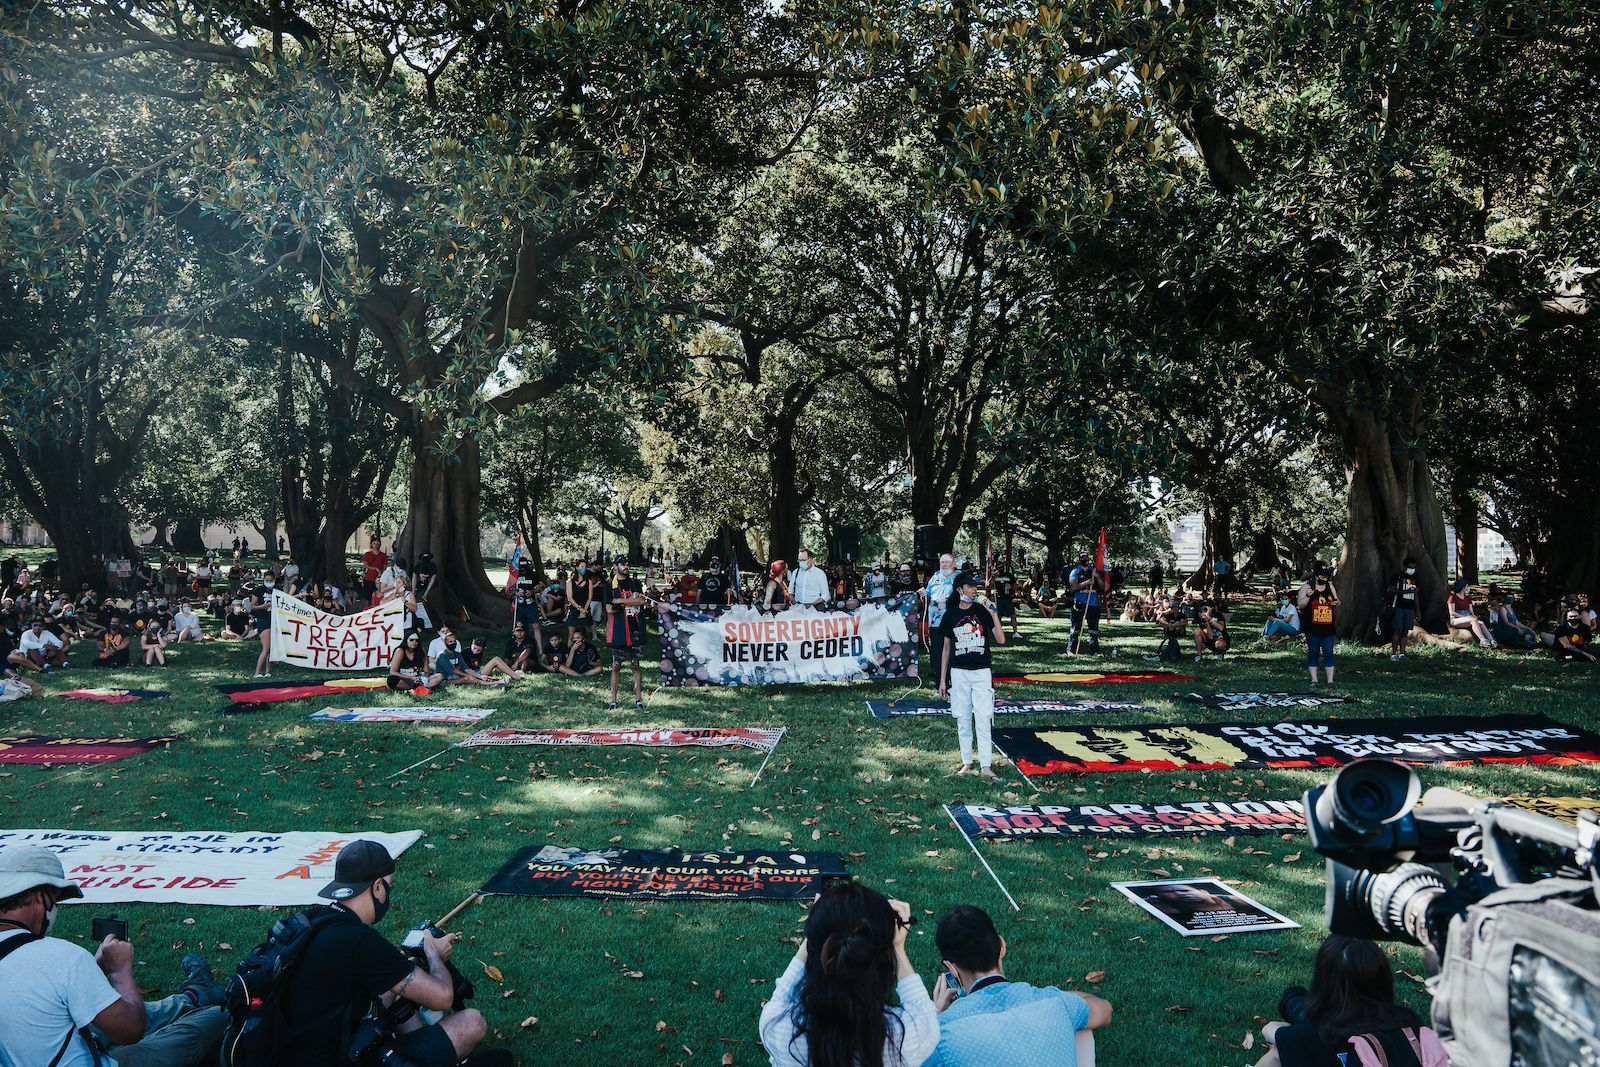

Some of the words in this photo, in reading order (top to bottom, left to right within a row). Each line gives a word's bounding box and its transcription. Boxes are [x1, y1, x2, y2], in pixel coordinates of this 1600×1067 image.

[313, 608, 385, 628] VOICE
[287, 619, 394, 649] TREATY
[724, 615, 861, 643] SOVEREIGNTY
[722, 642, 789, 662] NEVER
[800, 635, 864, 660] CEDED
[306, 645, 392, 668] TRUTH
[1220, 722, 1329, 736] STOP
[1239, 733, 1396, 748] BLACK
[1258, 745, 1317, 758] IN
[1332, 738, 1548, 757] CUSTODY
[972, 813, 1069, 830] NOT
[1069, 824, 1136, 834] FOR
[1140, 824, 1227, 833] CLAN
[116, 843, 286, 854] CUSTODY
[68, 864, 156, 874] NOT
[527, 862, 569, 872] YOU
[572, 863, 617, 872] MAY
[620, 866, 662, 874] KILL
[665, 866, 709, 875] OUR
[715, 866, 820, 876] WARRIORS
[532, 871, 572, 879] BUT
[577, 872, 643, 882] YOU'LL
[649, 873, 715, 883] NEVER
[722, 874, 764, 883] KILL
[768, 875, 813, 883] OUR
[571, 879, 633, 889] FIGHT
[638, 881, 678, 890] FOR
[683, 882, 765, 892] JUSTICE
